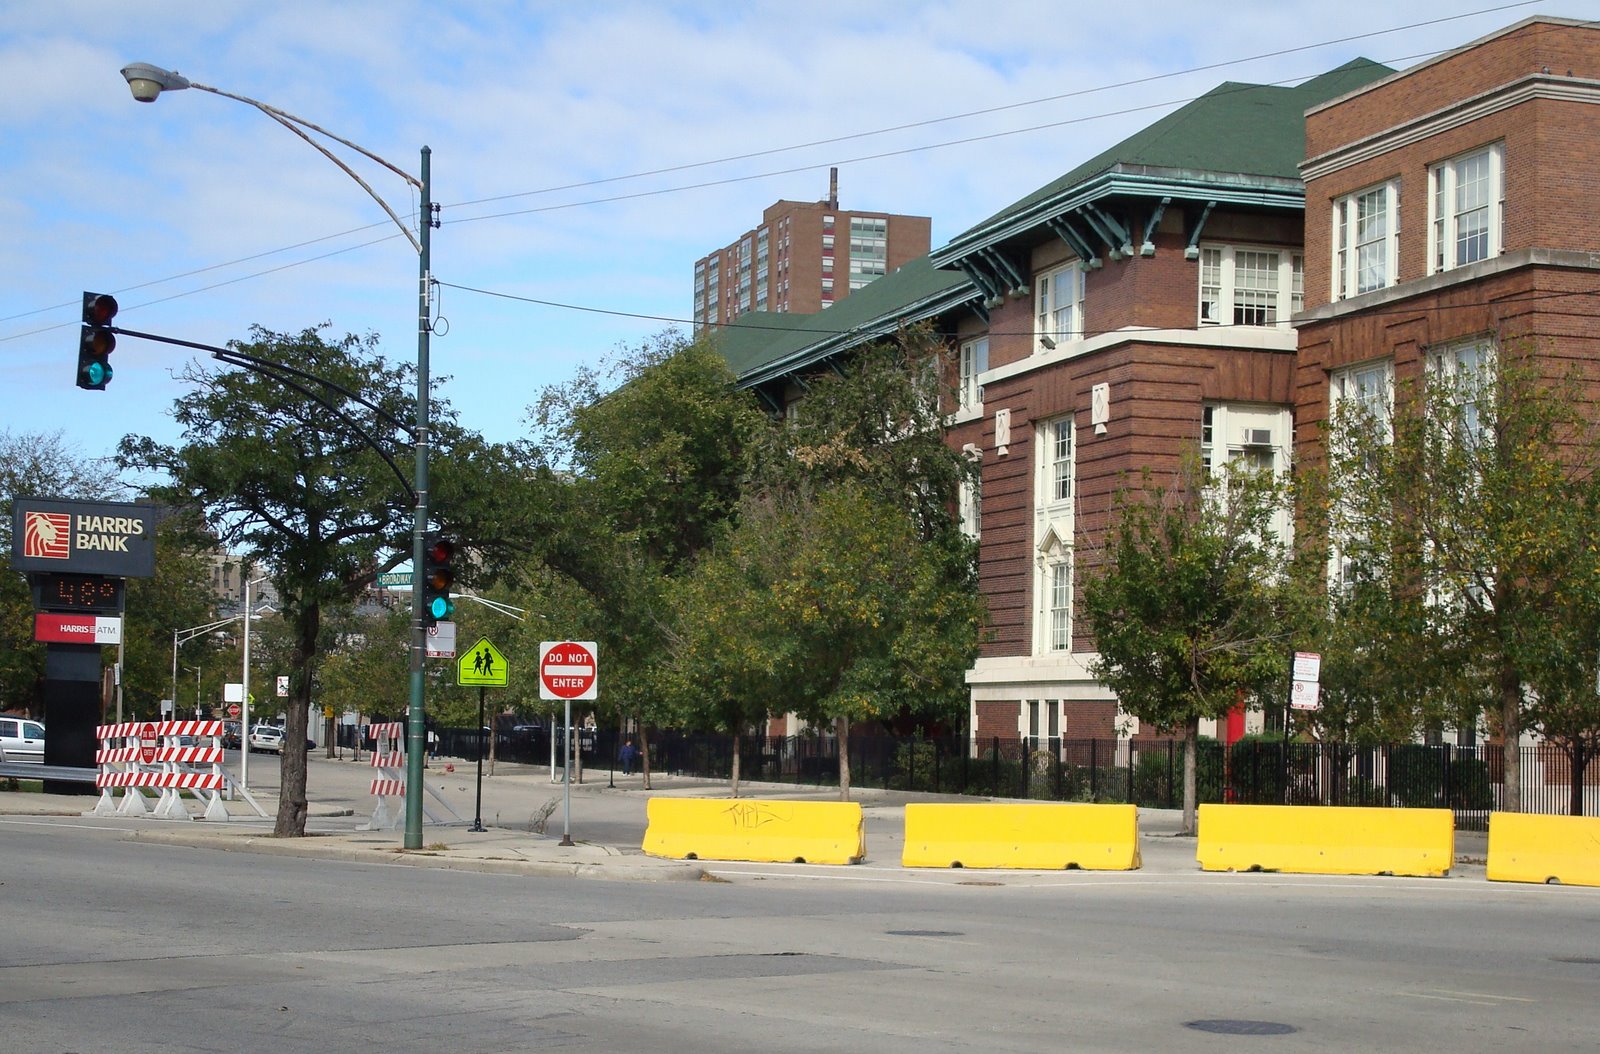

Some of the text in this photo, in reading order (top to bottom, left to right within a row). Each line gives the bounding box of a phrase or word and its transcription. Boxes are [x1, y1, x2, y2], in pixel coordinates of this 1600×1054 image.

[77, 515, 143, 534] HARRIS
[77, 534, 128, 552] BANK
[382, 574, 411, 584] BROADWAY
[60, 624, 117, 635] HARRIS ATM
[549, 653, 588, 663] DO NOT
[552, 678, 584, 688] ENTER
